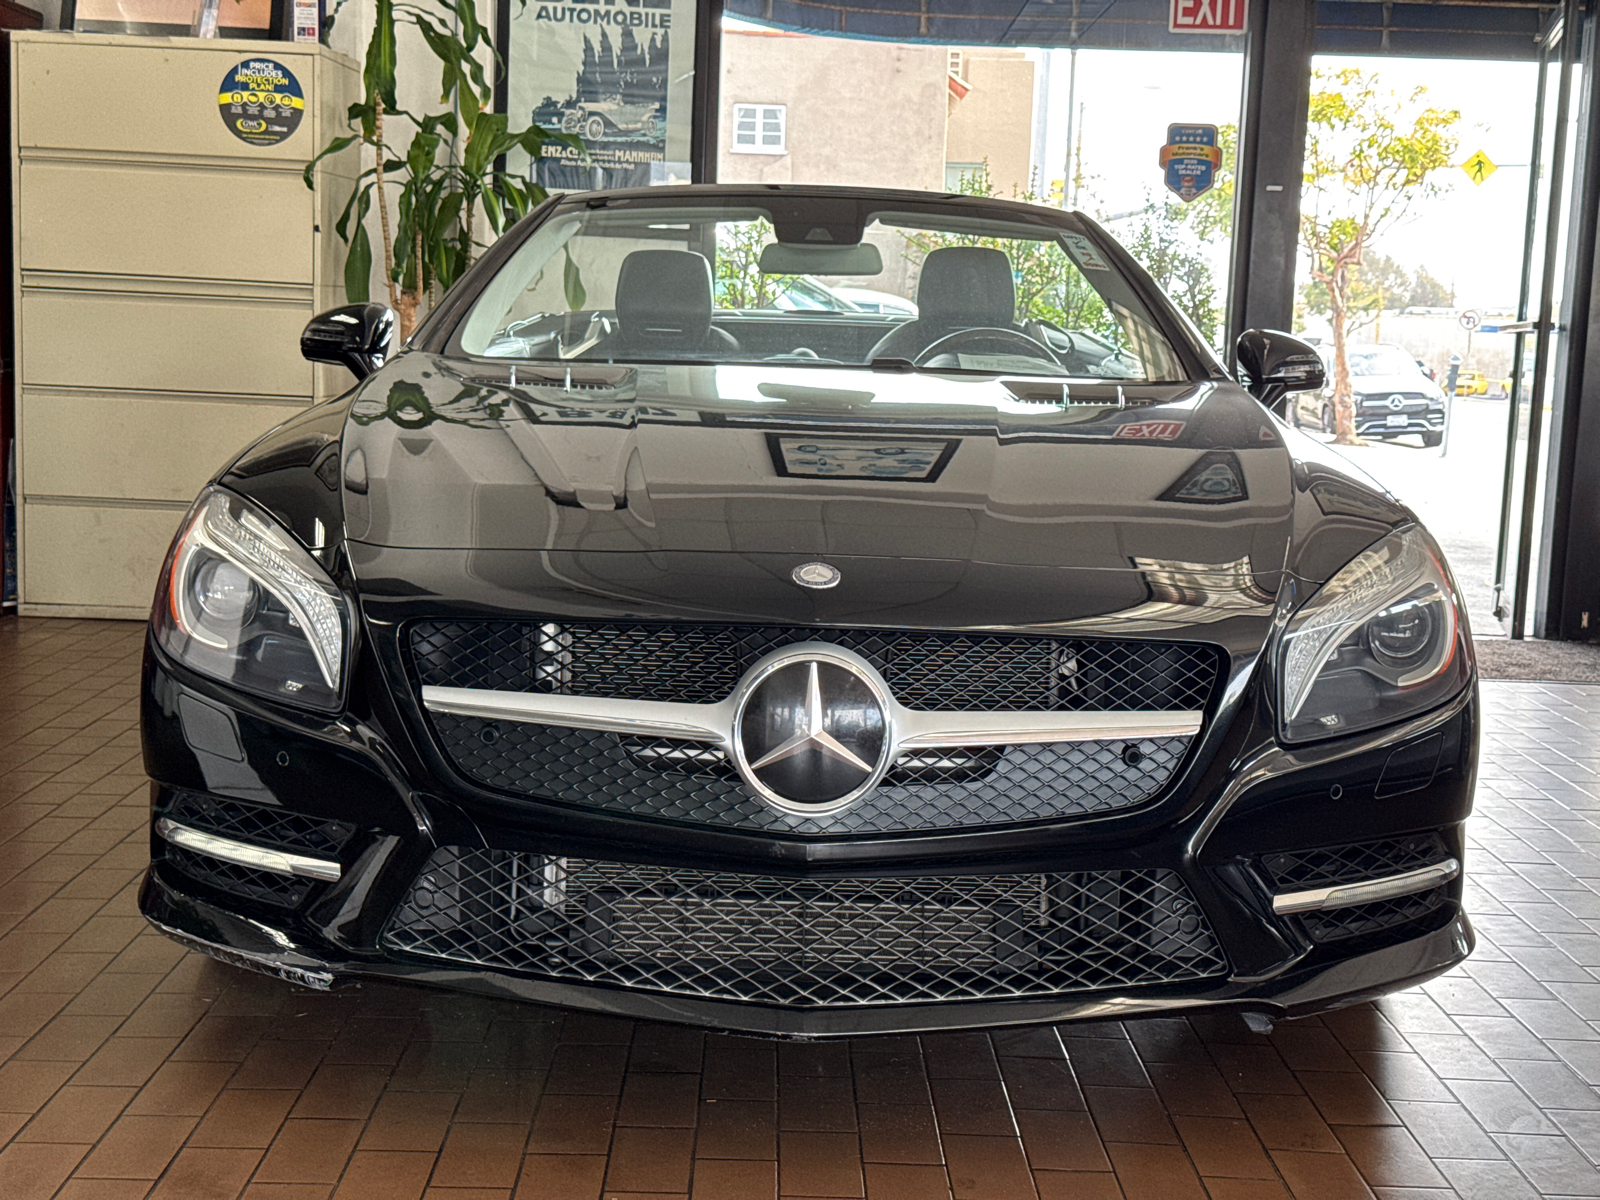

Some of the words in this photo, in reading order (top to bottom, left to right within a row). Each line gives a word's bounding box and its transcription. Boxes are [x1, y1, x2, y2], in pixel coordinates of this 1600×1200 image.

[535, 5, 672, 30] AUTOMOBILE
[1176, 0, 1236, 26] EXIT
[250, 61, 275, 70] PRICE
[241, 68, 283, 78] INCLUDES
[234, 75, 289, 86] PROTECTION
[249, 83, 275, 92] PLAN!
[242, 119, 260, 128] GWC
[615, 149, 664, 164] MANNHEIM
[1172, 151, 1210, 159] Motorcars
[1174, 164, 1207, 172] TOP-RATED
